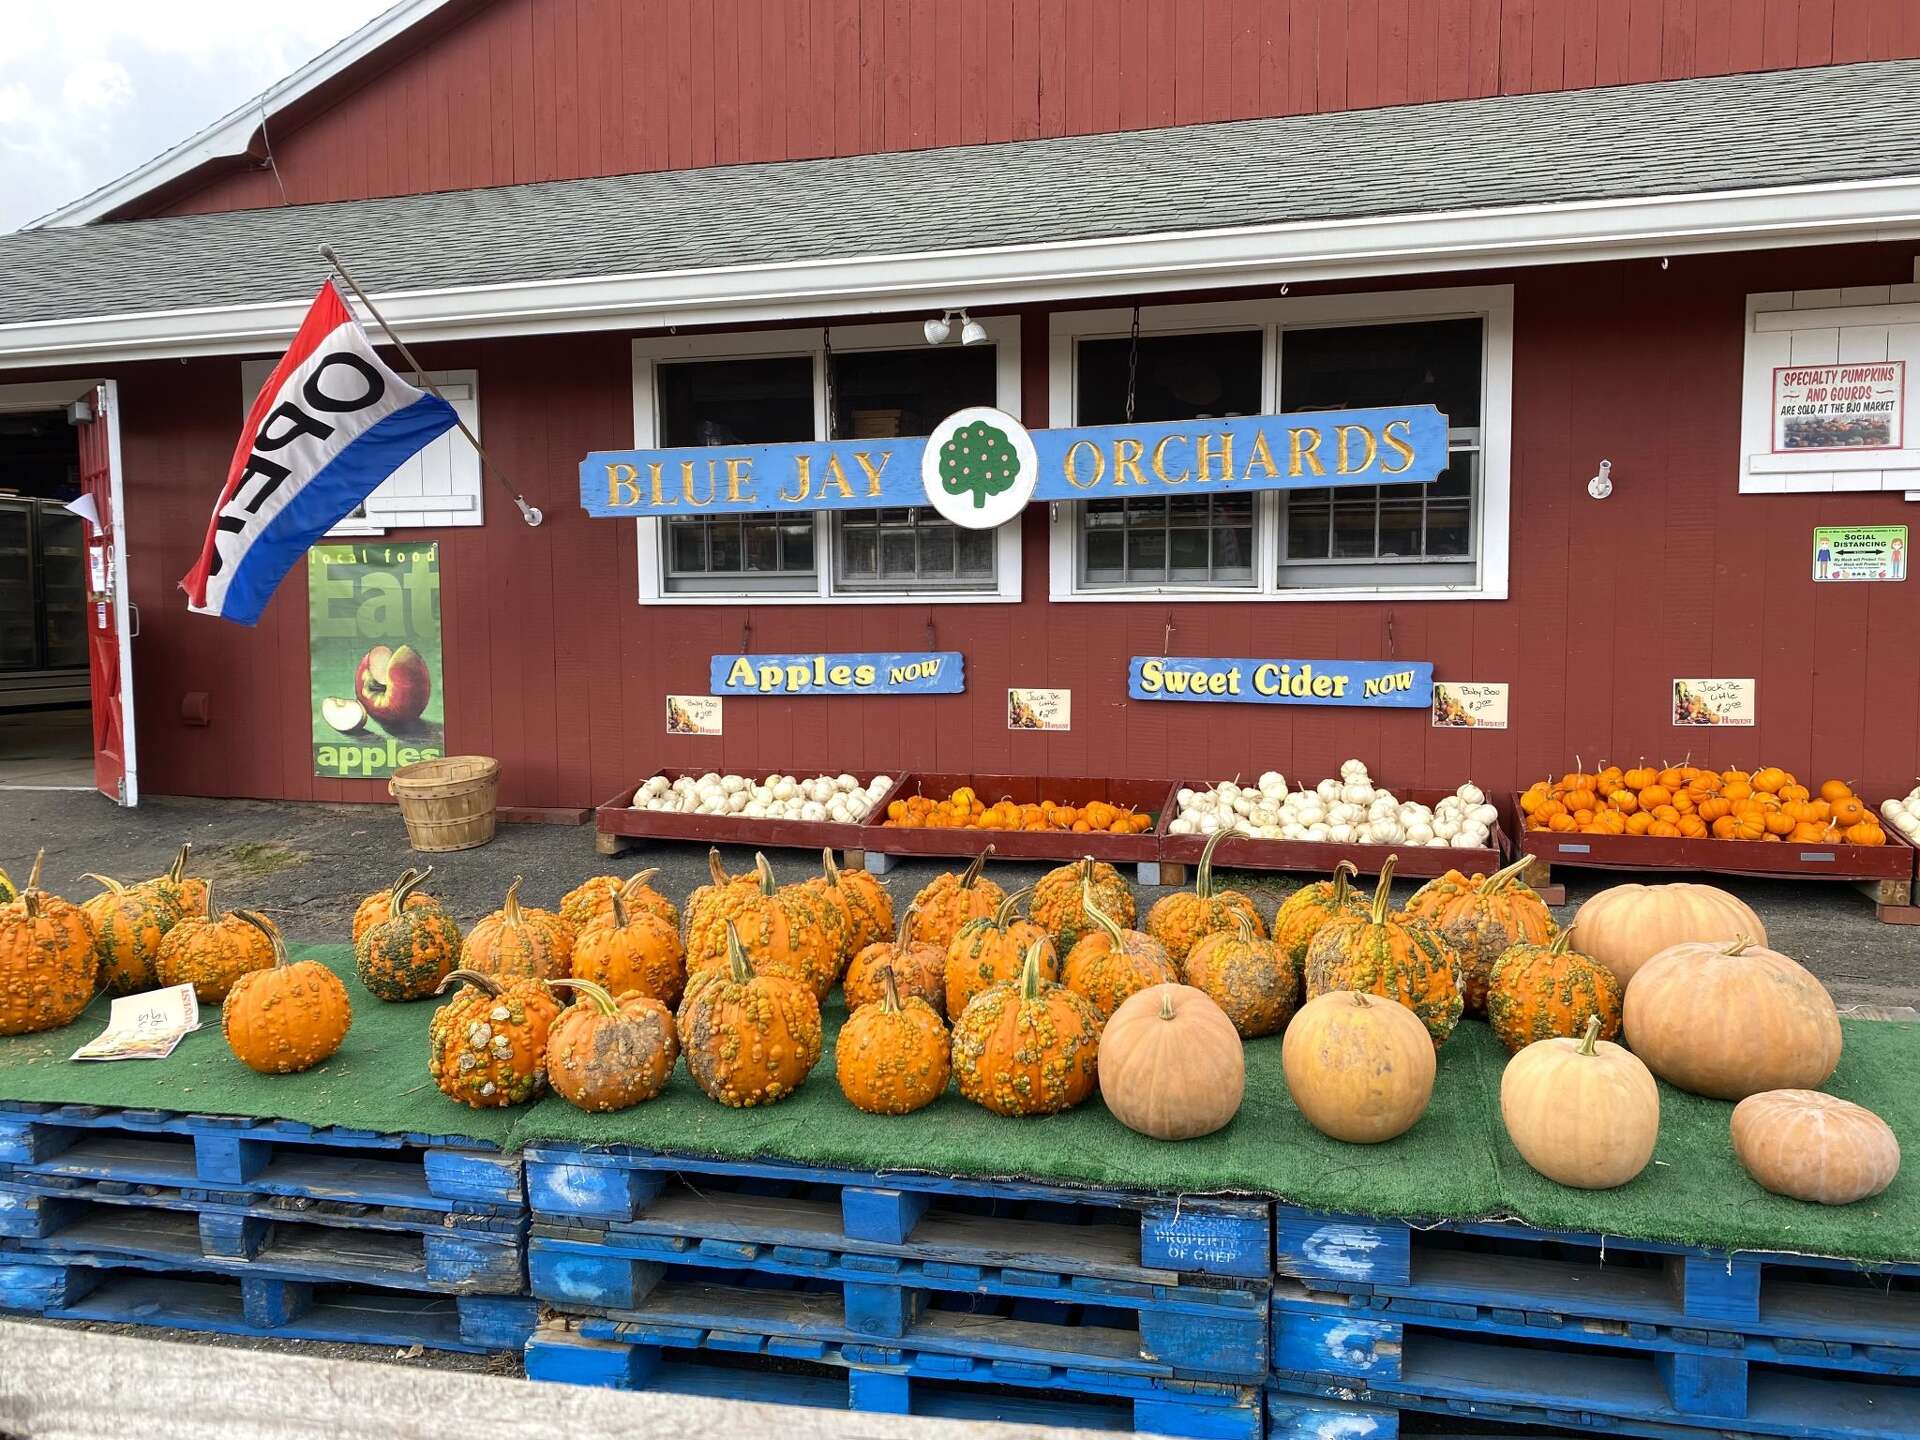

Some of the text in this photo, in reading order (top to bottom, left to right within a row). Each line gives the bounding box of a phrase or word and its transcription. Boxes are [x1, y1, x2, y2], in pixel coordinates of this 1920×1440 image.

[1783, 366, 1895, 387] SPECIALTY PUMPKINS
[1806, 385, 1872, 402] AND GOURDS
[1780, 405, 1796, 416] ARE
[1798, 404, 1816, 415] SOLD
[1818, 403, 1828, 414] AT
[1831, 403, 1844, 413] THE
[1863, 400, 1895, 412] MARKET
[604, 418, 1416, 508] BLUE JAY ORCHARDS
[310, 547, 435, 564] local food
[315, 545, 440, 638] Eat
[726, 656, 942, 693] Apples NOW
[1140, 660, 1416, 699] Sweet Cider NOW
[316, 739, 441, 776] apples
[1155, 1230, 1235, 1249] PROPERTY
[1168, 1247, 1237, 1263] OF CHEP
